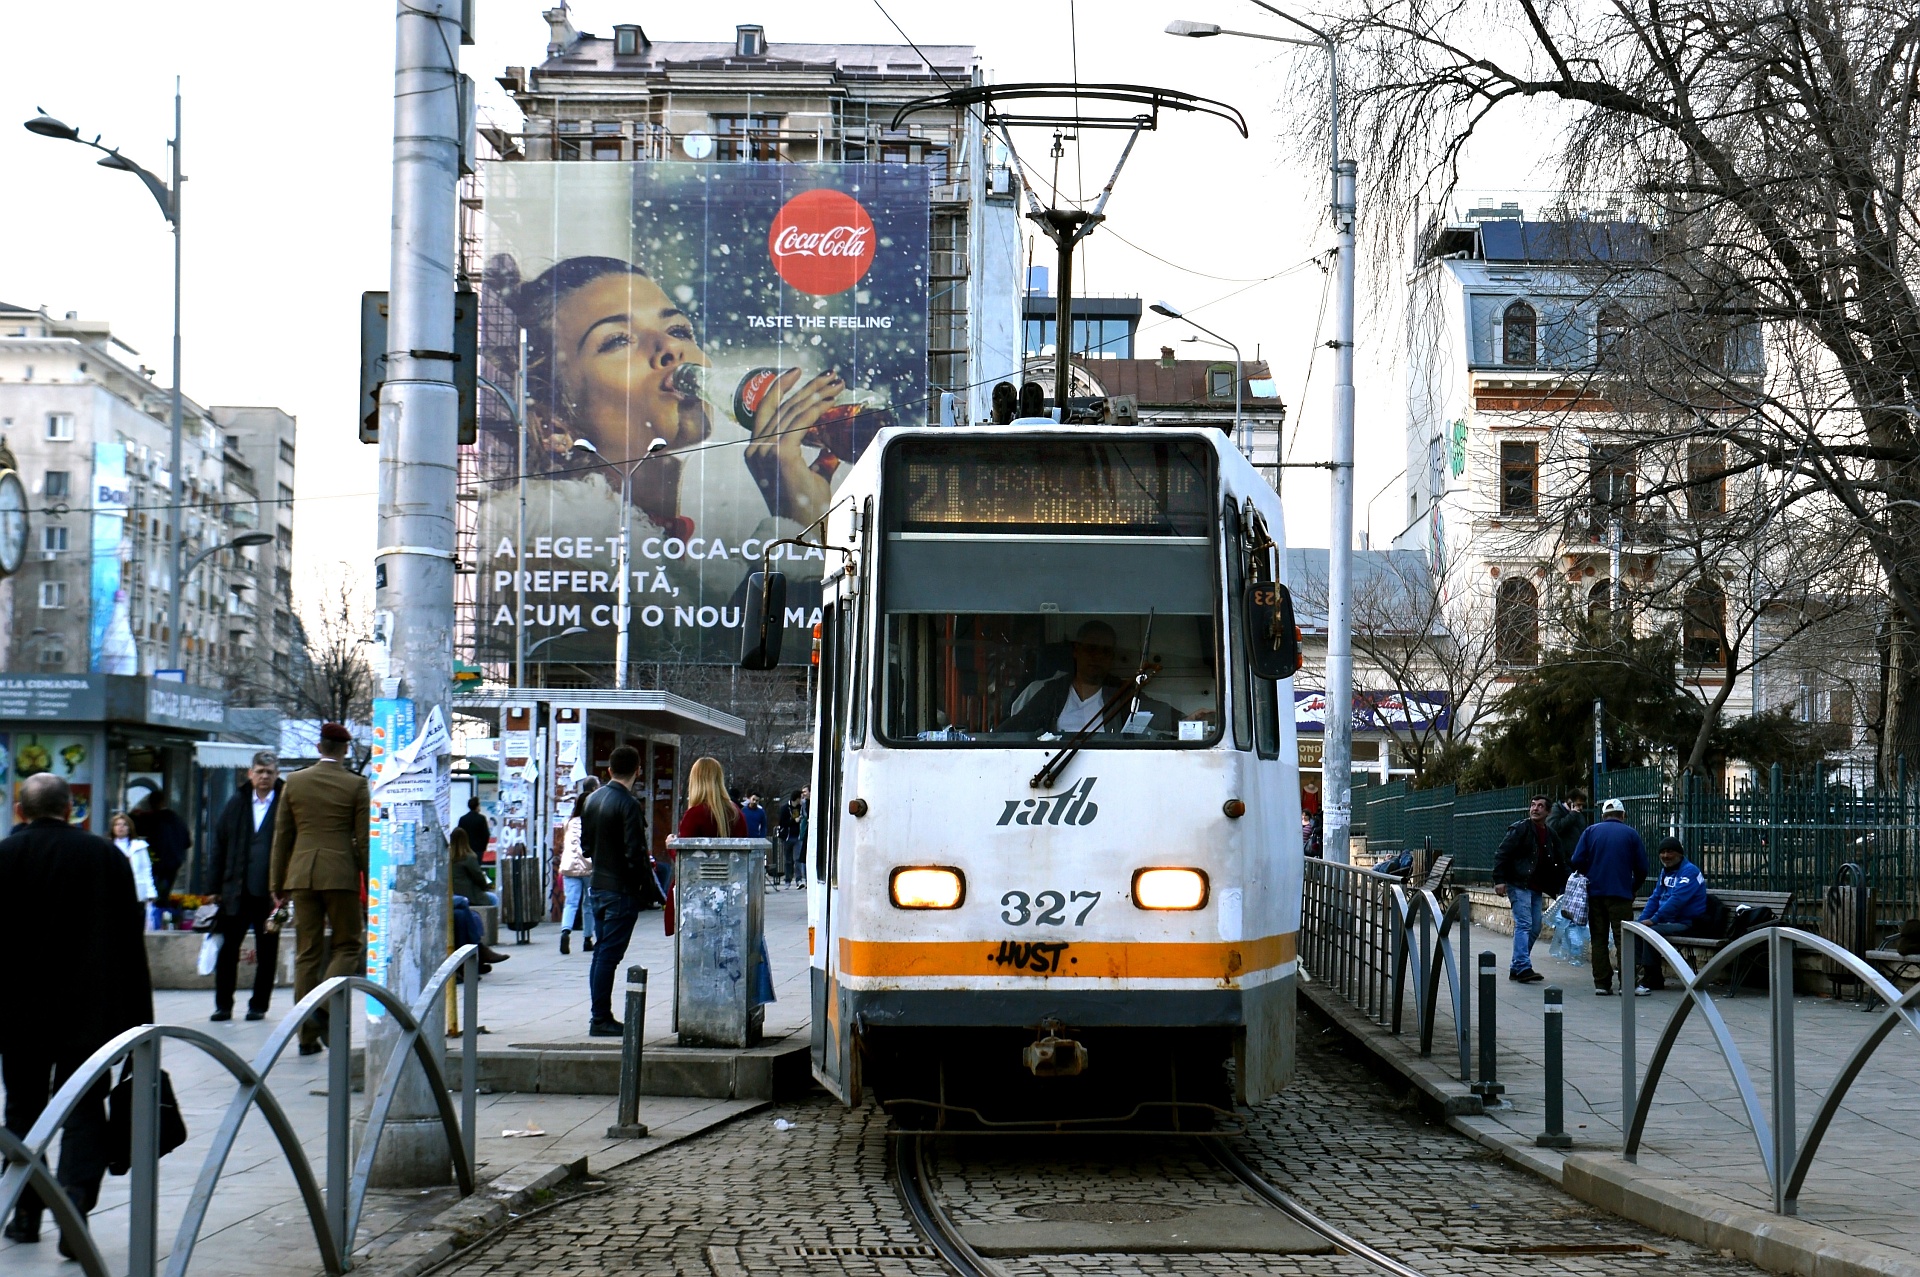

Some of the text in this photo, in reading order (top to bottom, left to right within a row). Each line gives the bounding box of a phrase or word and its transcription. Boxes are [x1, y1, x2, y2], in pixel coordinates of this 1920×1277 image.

[774, 226, 871, 257] Coca-Cola
[747, 315, 891, 328] TASTE THE FEELING
[909, 465, 961, 522] 21
[642, 537, 825, 561] COCA-COLA
[493, 604, 581, 627] ACUM
[641, 605, 665, 628] O
[675, 606, 745, 628] NOU
[996, 777, 1099, 826] ratb
[1000, 890, 1102, 927] 327
